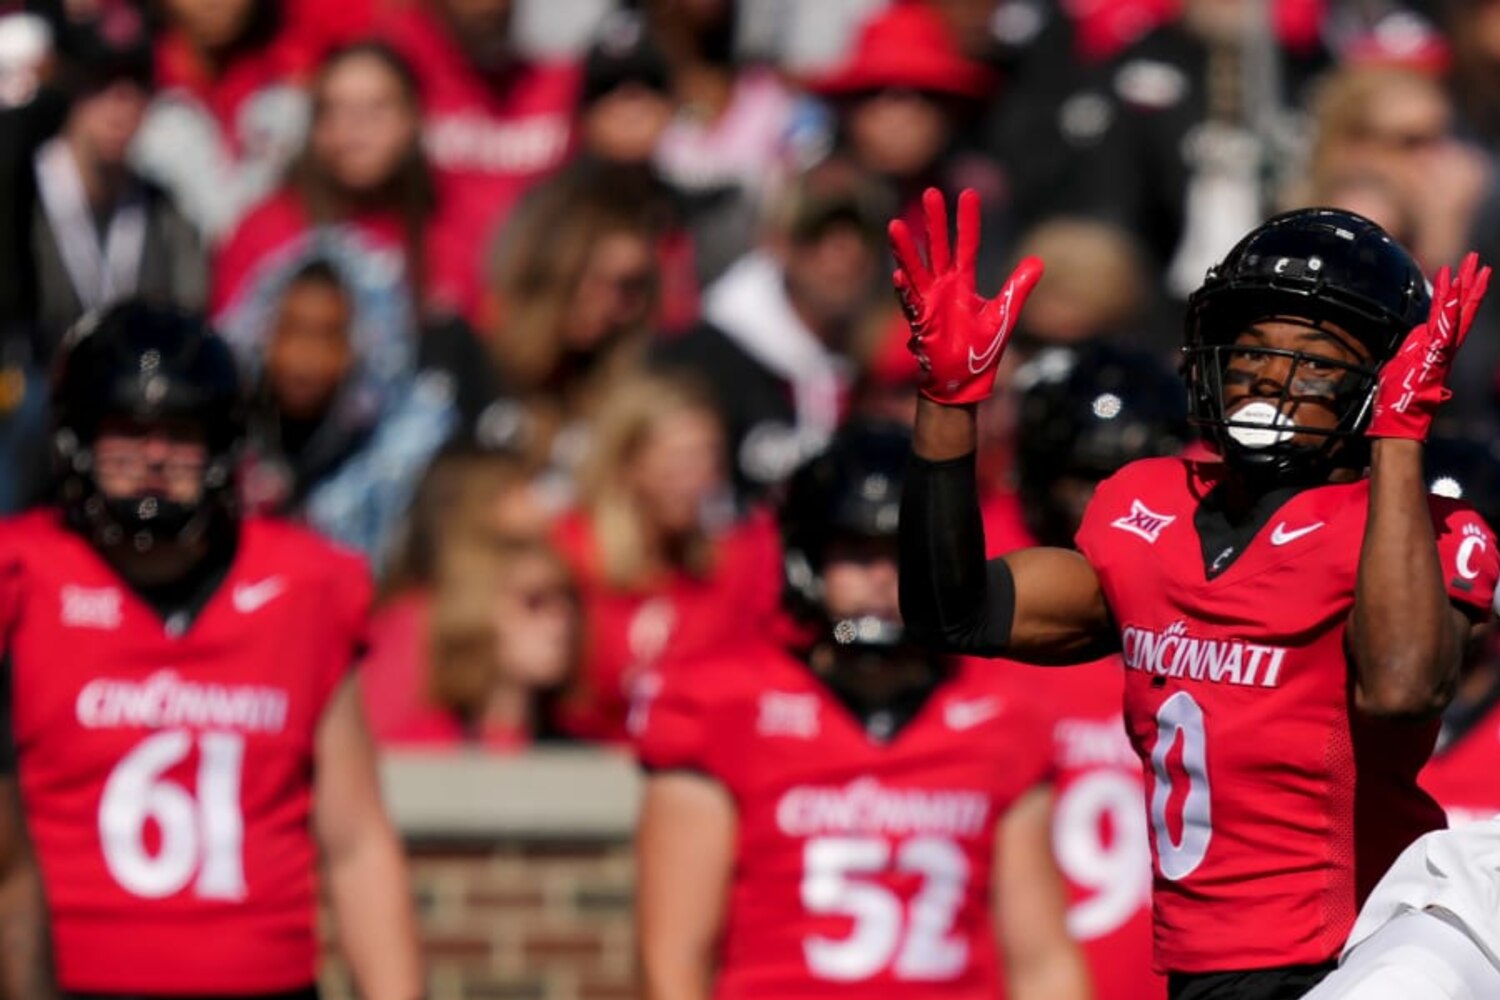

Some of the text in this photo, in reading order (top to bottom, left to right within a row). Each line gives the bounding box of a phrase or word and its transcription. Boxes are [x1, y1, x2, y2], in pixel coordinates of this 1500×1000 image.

[1456, 523, 1487, 579] C
[1122, 620, 1287, 688] CINCINNATI
[98, 726, 248, 902] 61
[1151, 690, 1212, 881] 0
[800, 836, 970, 983] 52
